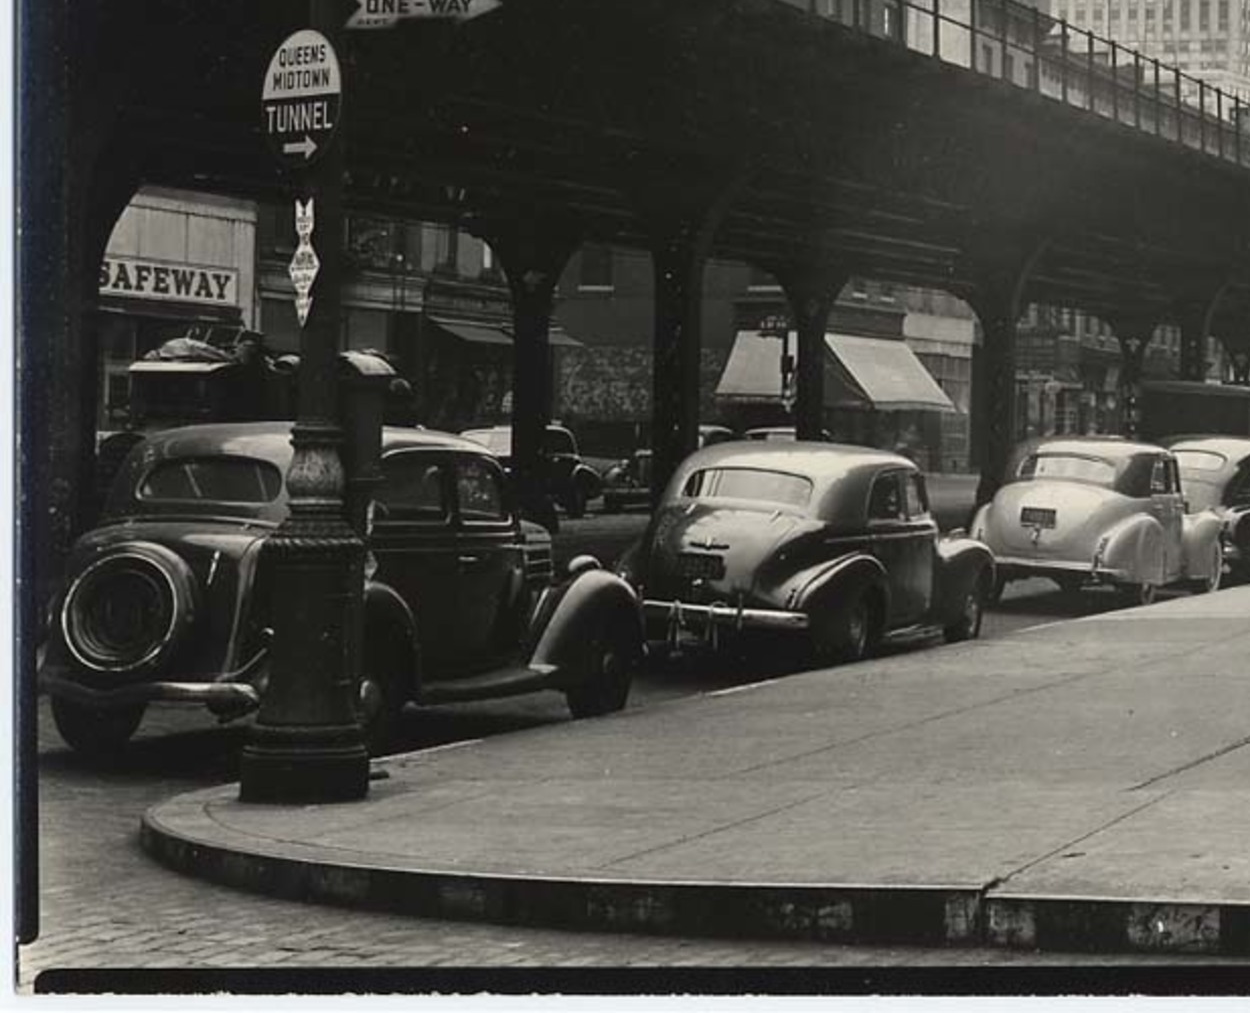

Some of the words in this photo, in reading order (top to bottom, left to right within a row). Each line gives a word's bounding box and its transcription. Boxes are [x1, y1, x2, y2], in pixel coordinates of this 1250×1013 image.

[278, 43, 327, 68] QUEENS
[272, 66, 331, 91] MIDTOWN
[265, 100, 333, 134] TUNNEL
[98, 261, 231, 300] SAFEWAY
